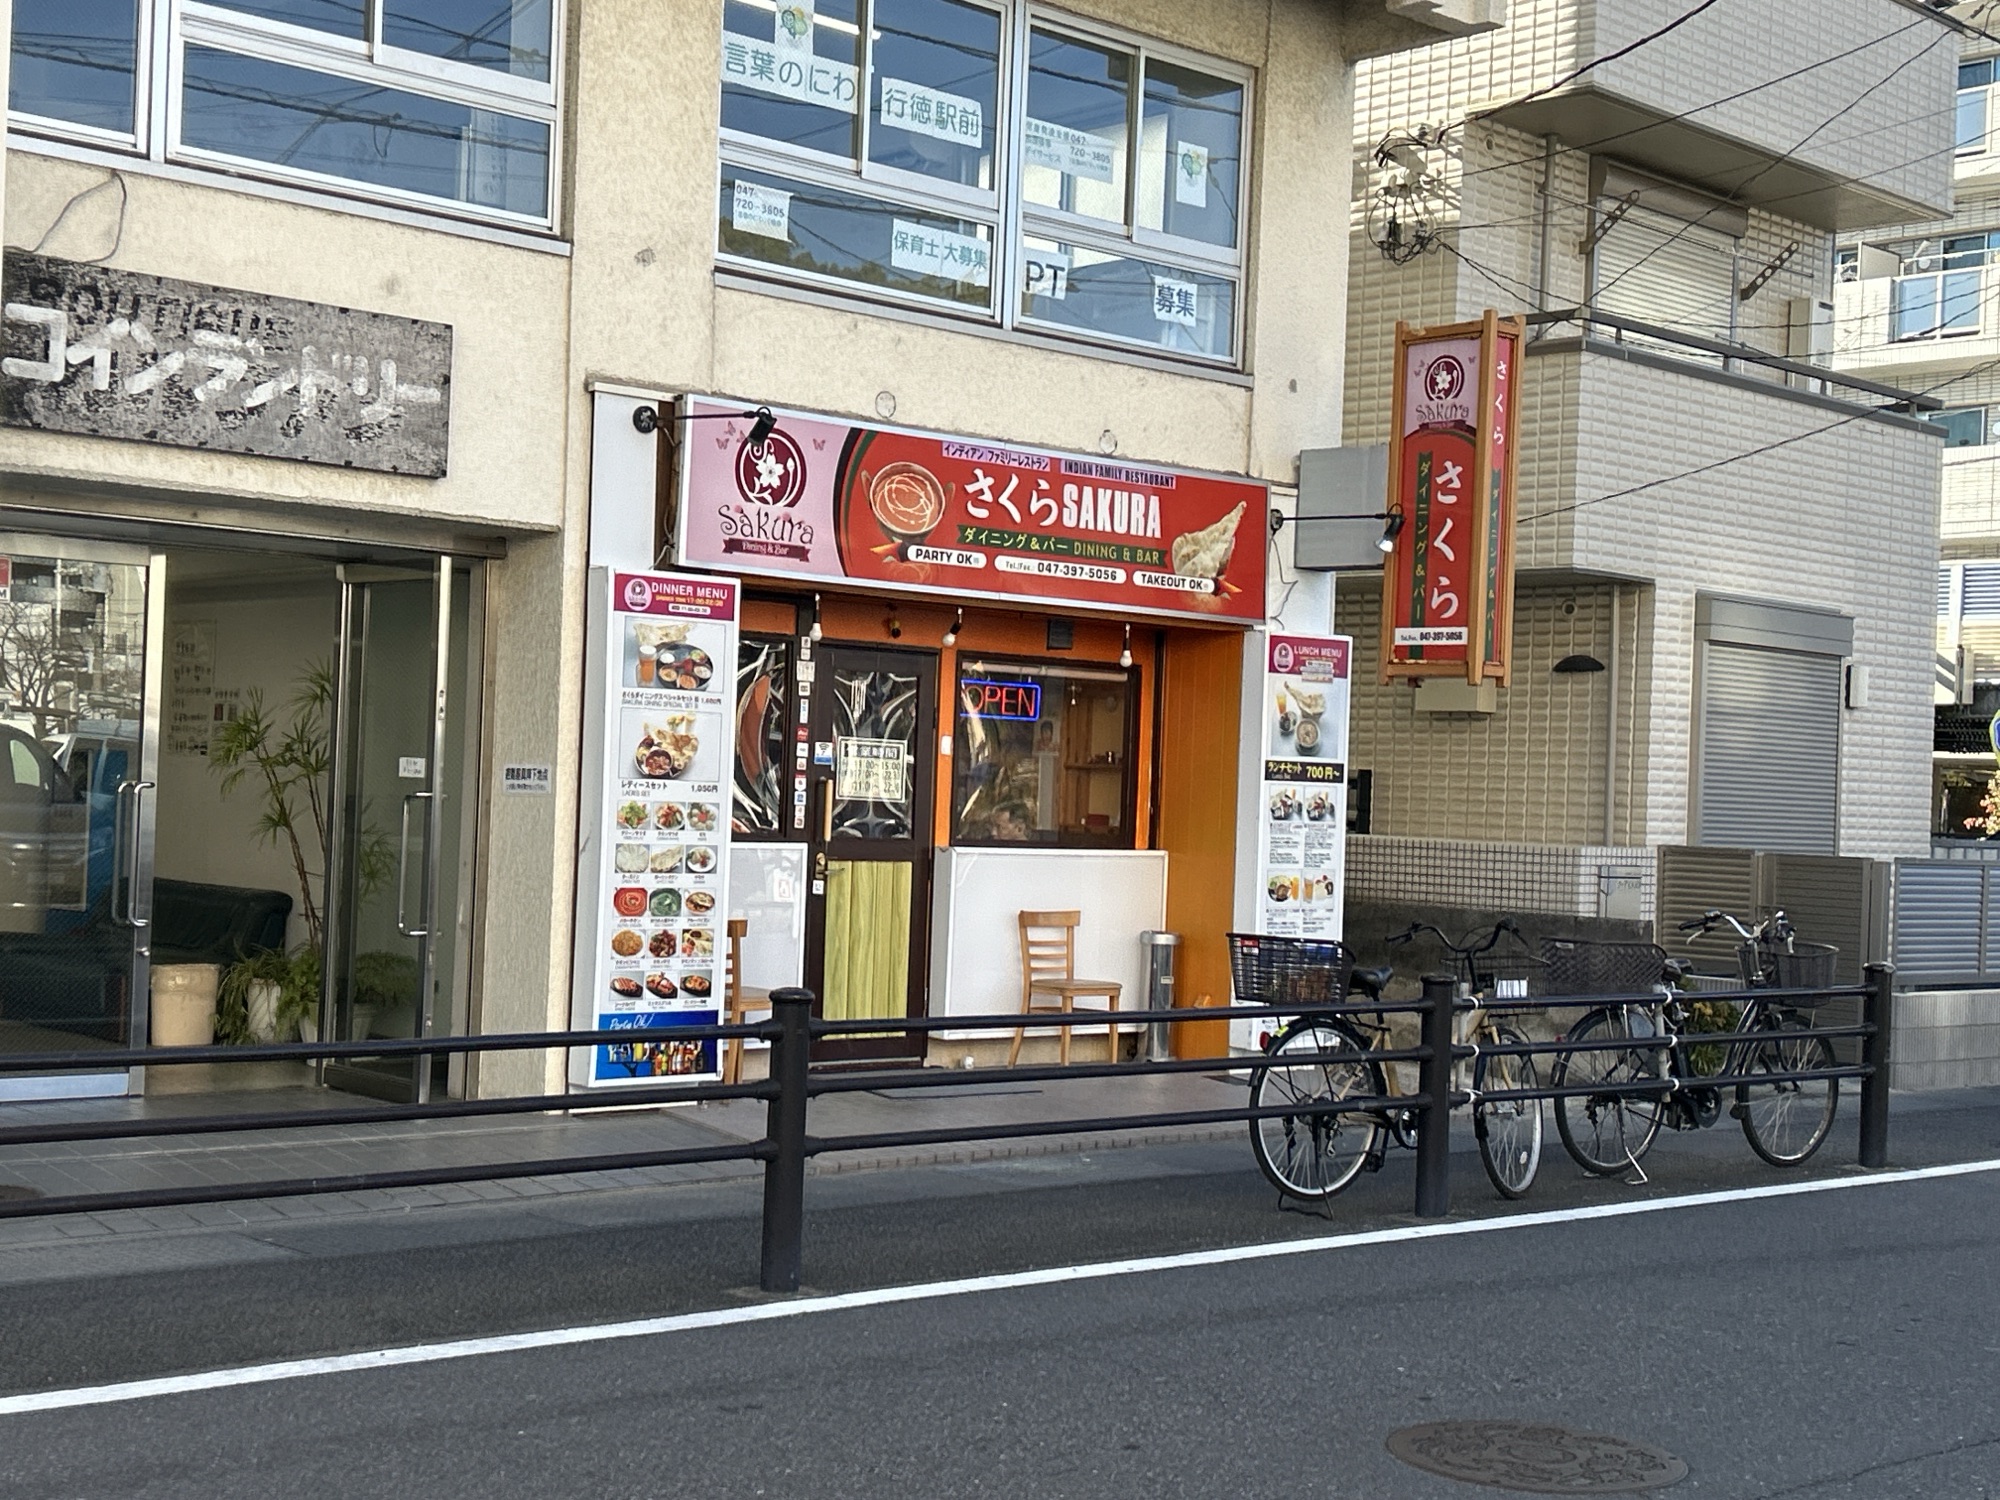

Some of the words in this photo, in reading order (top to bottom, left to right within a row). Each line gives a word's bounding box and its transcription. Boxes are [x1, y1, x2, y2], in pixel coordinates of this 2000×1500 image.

[724, 41, 856, 102] 言葉のにわ
[884, 87, 980, 138] 行徳駅前
[736, 184, 755, 198] 047
[735, 198, 785, 218] 720-3805
[1025, 260, 1066, 297] PT
[1155, 284, 1196, 318] 募集
[1415, 402, 1470, 422] Sakura
[1493, 360, 1507, 445] さくら
[1064, 459, 1094, 476] INDIAN
[1095, 463, 1122, 480] FAMILY
[1124, 469, 1174, 488] RESTAURANT
[718, 504, 814, 545] Sakura
[742, 541, 767, 555] Dining
[1431, 460, 1464, 619] さくら
[915, 548, 954, 564] PARTY
[1073, 541, 1117, 560] DINING
[1122, 548, 1130, 561] &
[1136, 549, 1160, 564] BAR
[1037, 562, 1117, 581] 047-397-5056
[1141, 573, 1187, 589] TAKEOUT
[651, 582, 693, 596] DINNER
[696, 586, 728, 599] MENU
[1419, 631, 1463, 641] 047-397-5056
[1293, 645, 1319, 656] LUNCH
[1320, 647, 1342, 658] MENU
[963, 686, 1035, 716] OPEN
[621, 780, 668, 791] レディースセット
